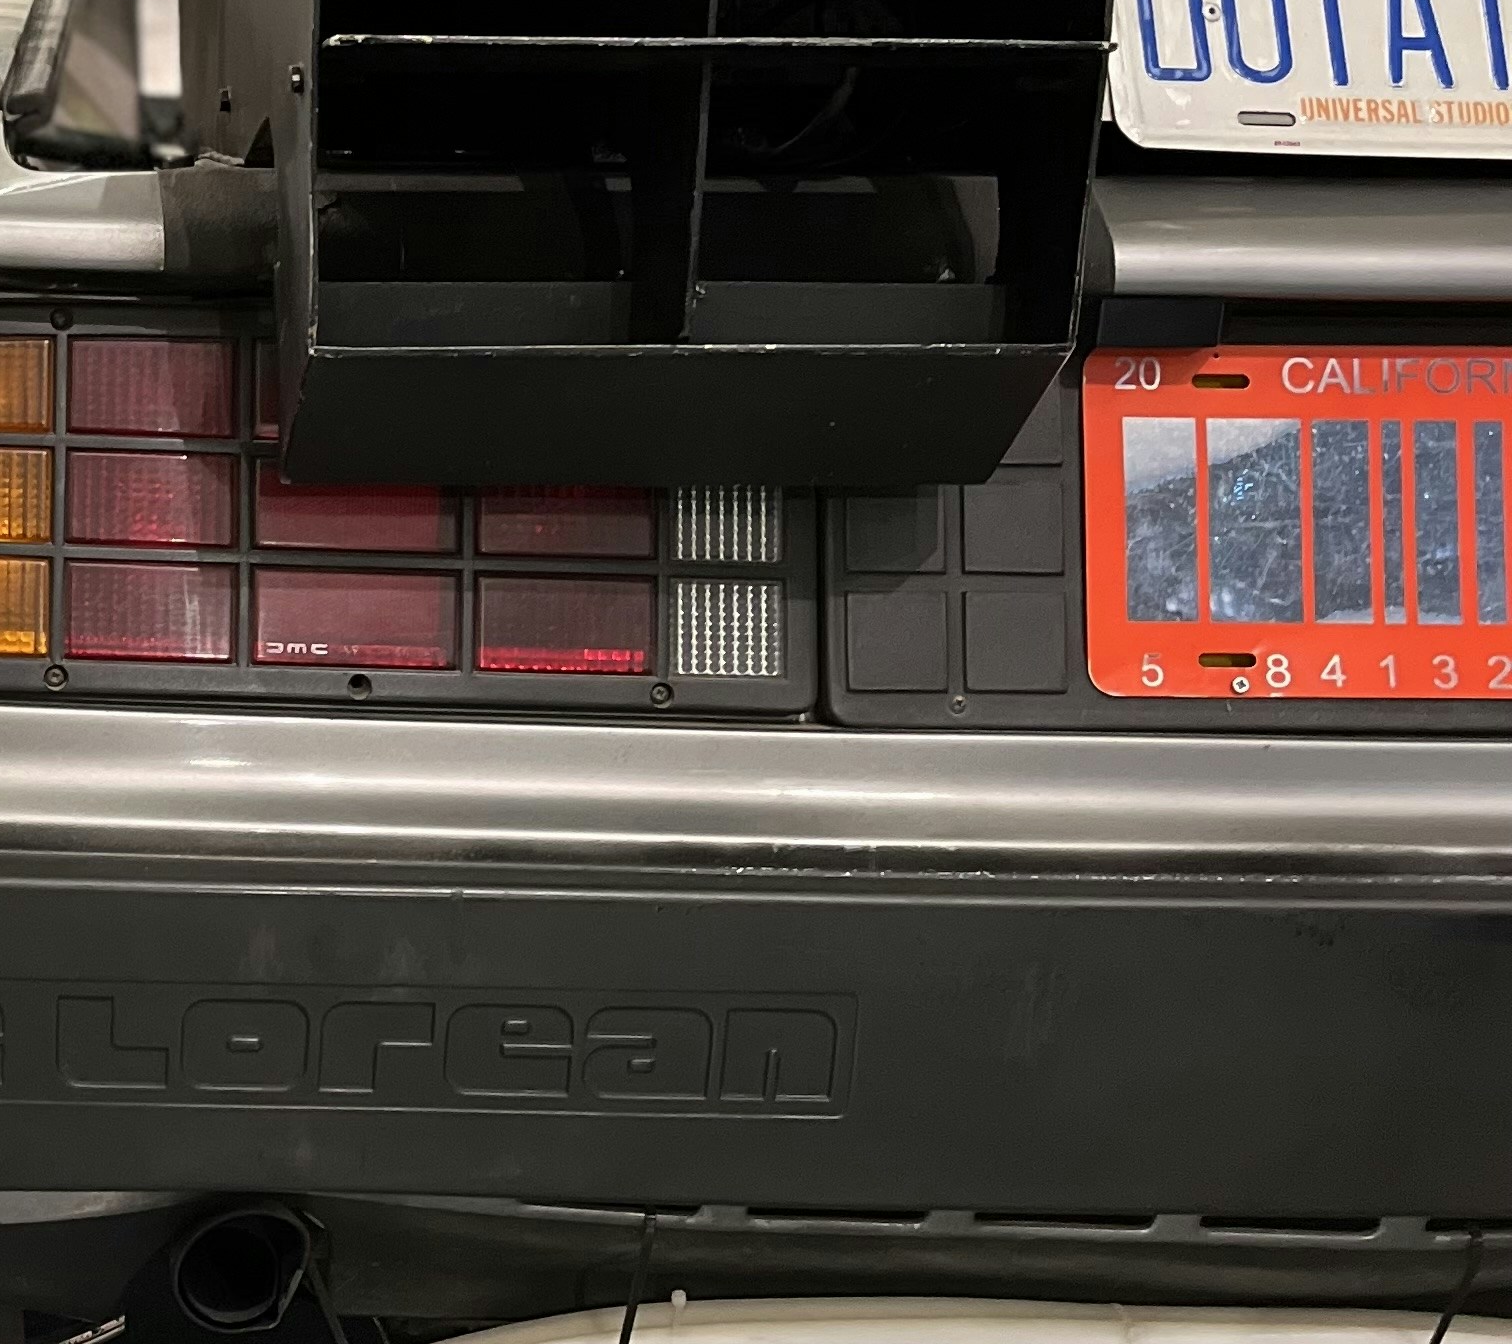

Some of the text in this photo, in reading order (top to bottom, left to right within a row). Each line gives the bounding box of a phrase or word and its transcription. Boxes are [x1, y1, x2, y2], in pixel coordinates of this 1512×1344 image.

[1300, 97, 1422, 124] UNIVERSAL
[1114, 357, 1161, 391] 20
[1140, 654, 1512, 690] 5 8 4 1 3 2
